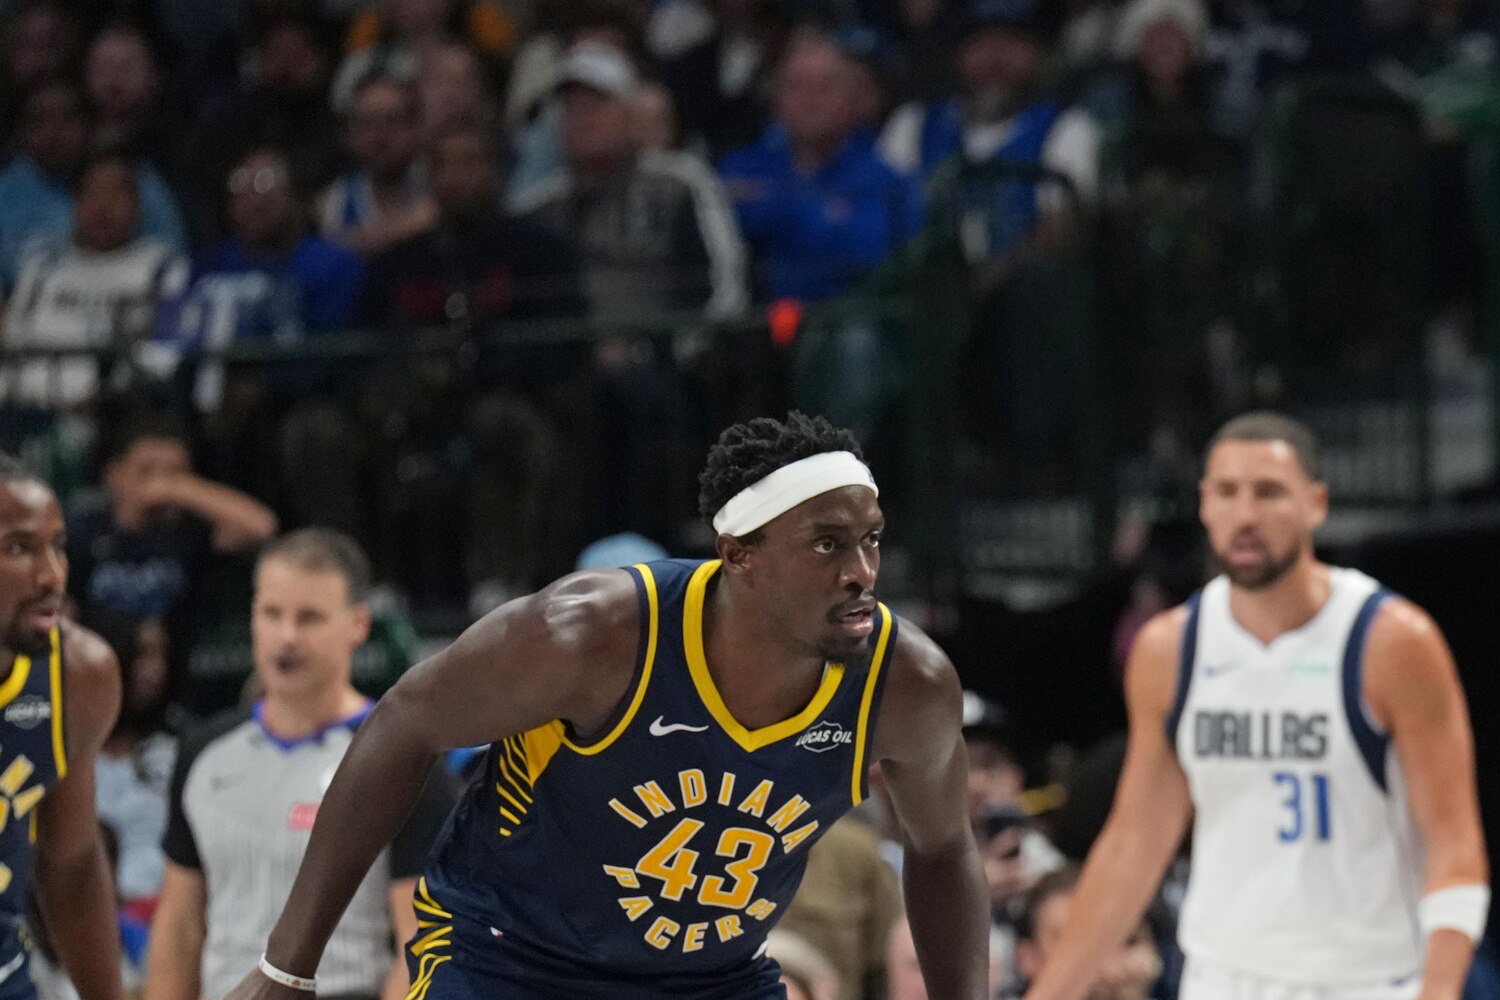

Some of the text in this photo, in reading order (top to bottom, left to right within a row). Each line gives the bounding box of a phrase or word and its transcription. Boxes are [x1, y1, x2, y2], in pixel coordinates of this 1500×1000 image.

[795, 729, 852, 747] LUCAS OIL
[1194, 710, 1329, 761] DALLAS
[608, 768, 819, 854] INDIANA
[1272, 772, 1330, 843] 31
[635, 817, 775, 910] 43
